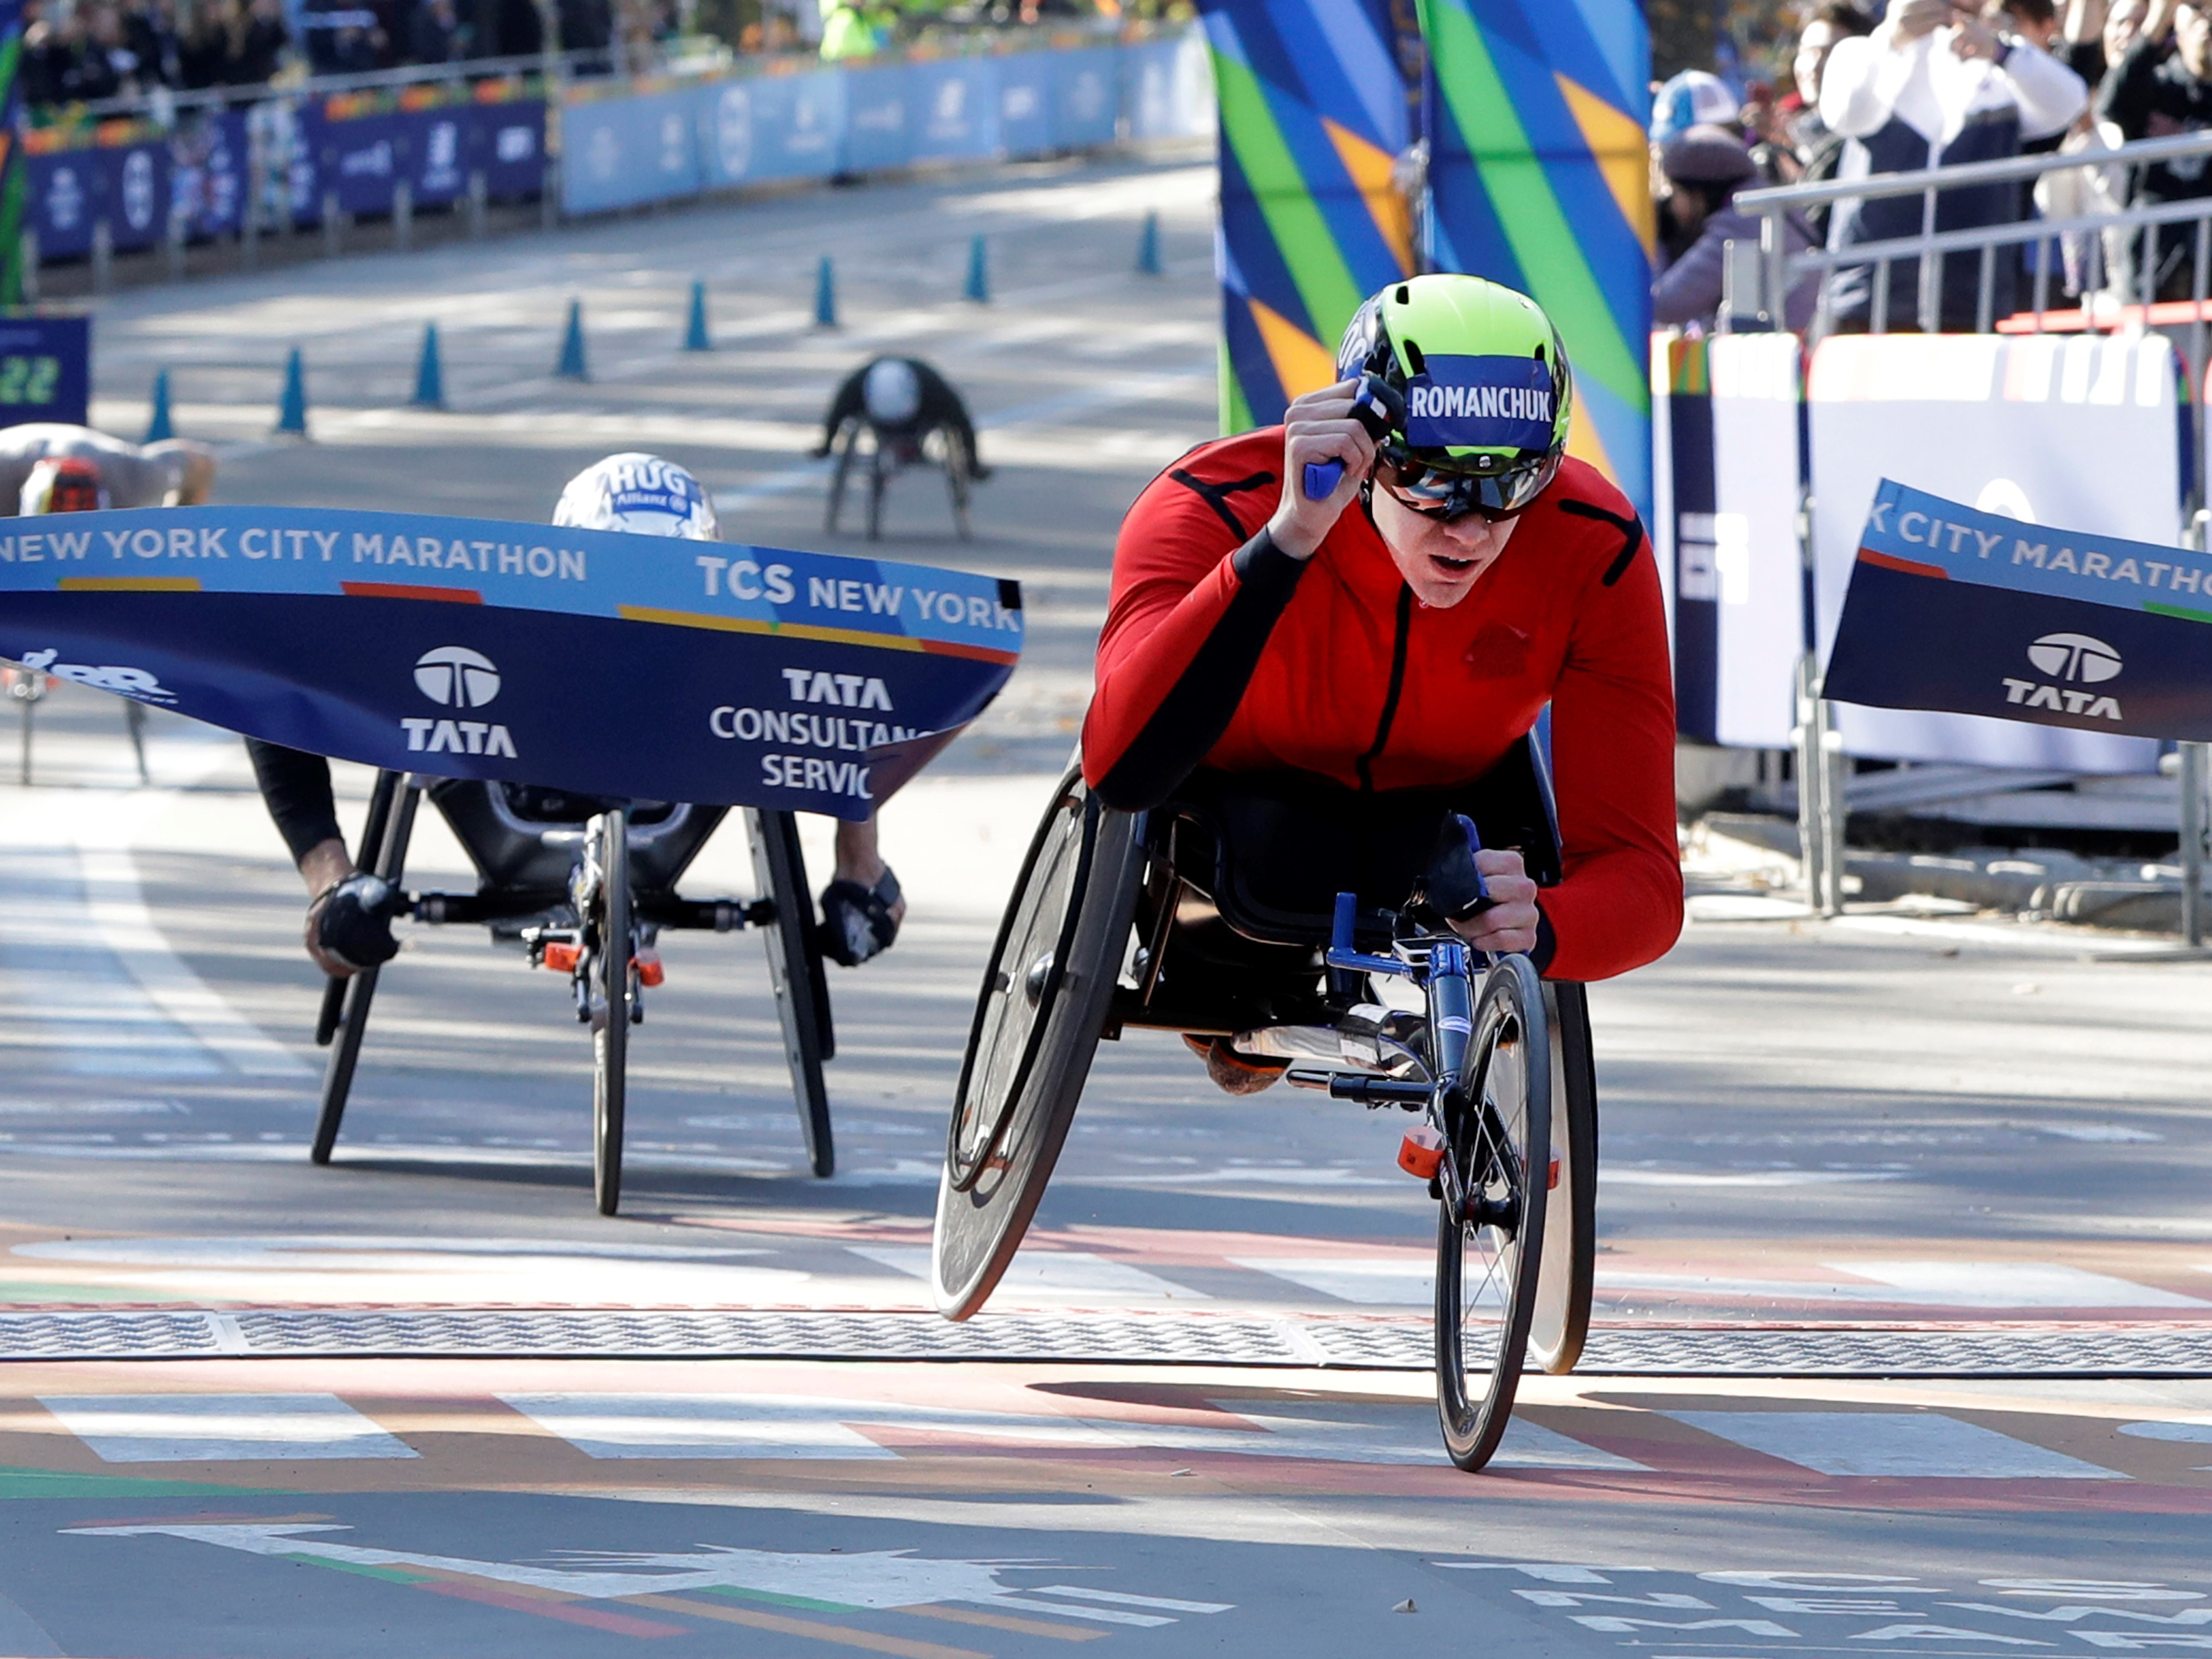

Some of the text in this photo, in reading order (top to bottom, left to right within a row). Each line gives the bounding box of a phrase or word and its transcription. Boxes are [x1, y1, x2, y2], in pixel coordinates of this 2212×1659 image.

[1412, 386, 1552, 422] ROMANCHUK
[610, 460, 686, 496] HUG
[0, 528, 586, 581] NEW YORK CITY MARATHON
[1898, 511, 2004, 559] CITY
[696, 555, 1020, 633] TCS NEW YORK
[782, 668, 893, 711] TATA
[2001, 678, 2123, 721] TATA
[401, 718, 518, 759] TATA
[710, 706, 935, 752] CONSULTA
[761, 754, 874, 800] SERVIC
